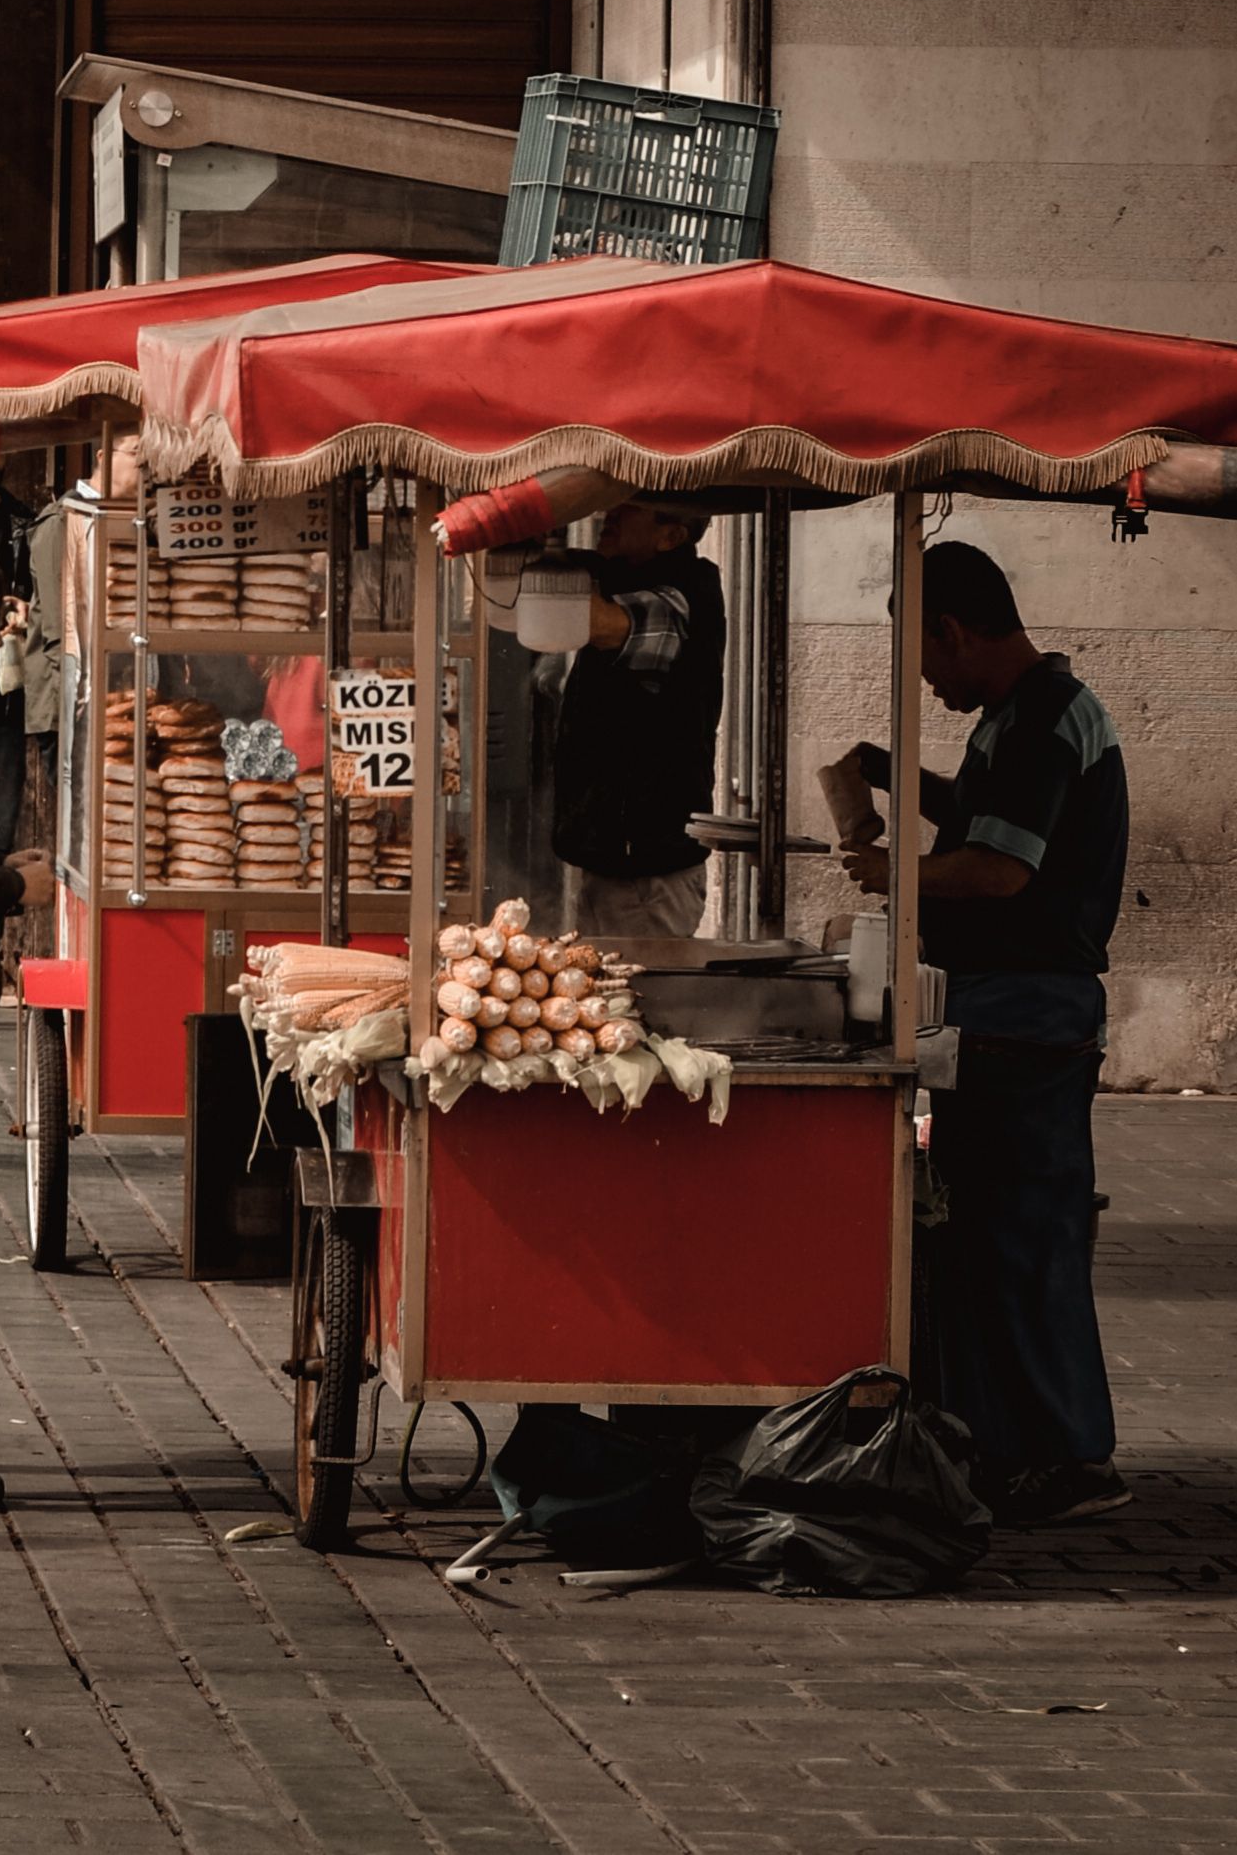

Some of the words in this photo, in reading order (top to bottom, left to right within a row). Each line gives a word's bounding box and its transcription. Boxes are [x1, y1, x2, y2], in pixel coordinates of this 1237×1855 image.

[169, 488, 221, 501] 100
[169, 504, 222, 518] 200
[232, 504, 257, 517] gr
[170, 520, 222, 534] 300
[232, 520, 258, 533] gr
[170, 536, 223, 550] 400
[233, 536, 259, 549] gr
[340, 680, 448, 709] KÖZ
[361, 752, 414, 787] 12
